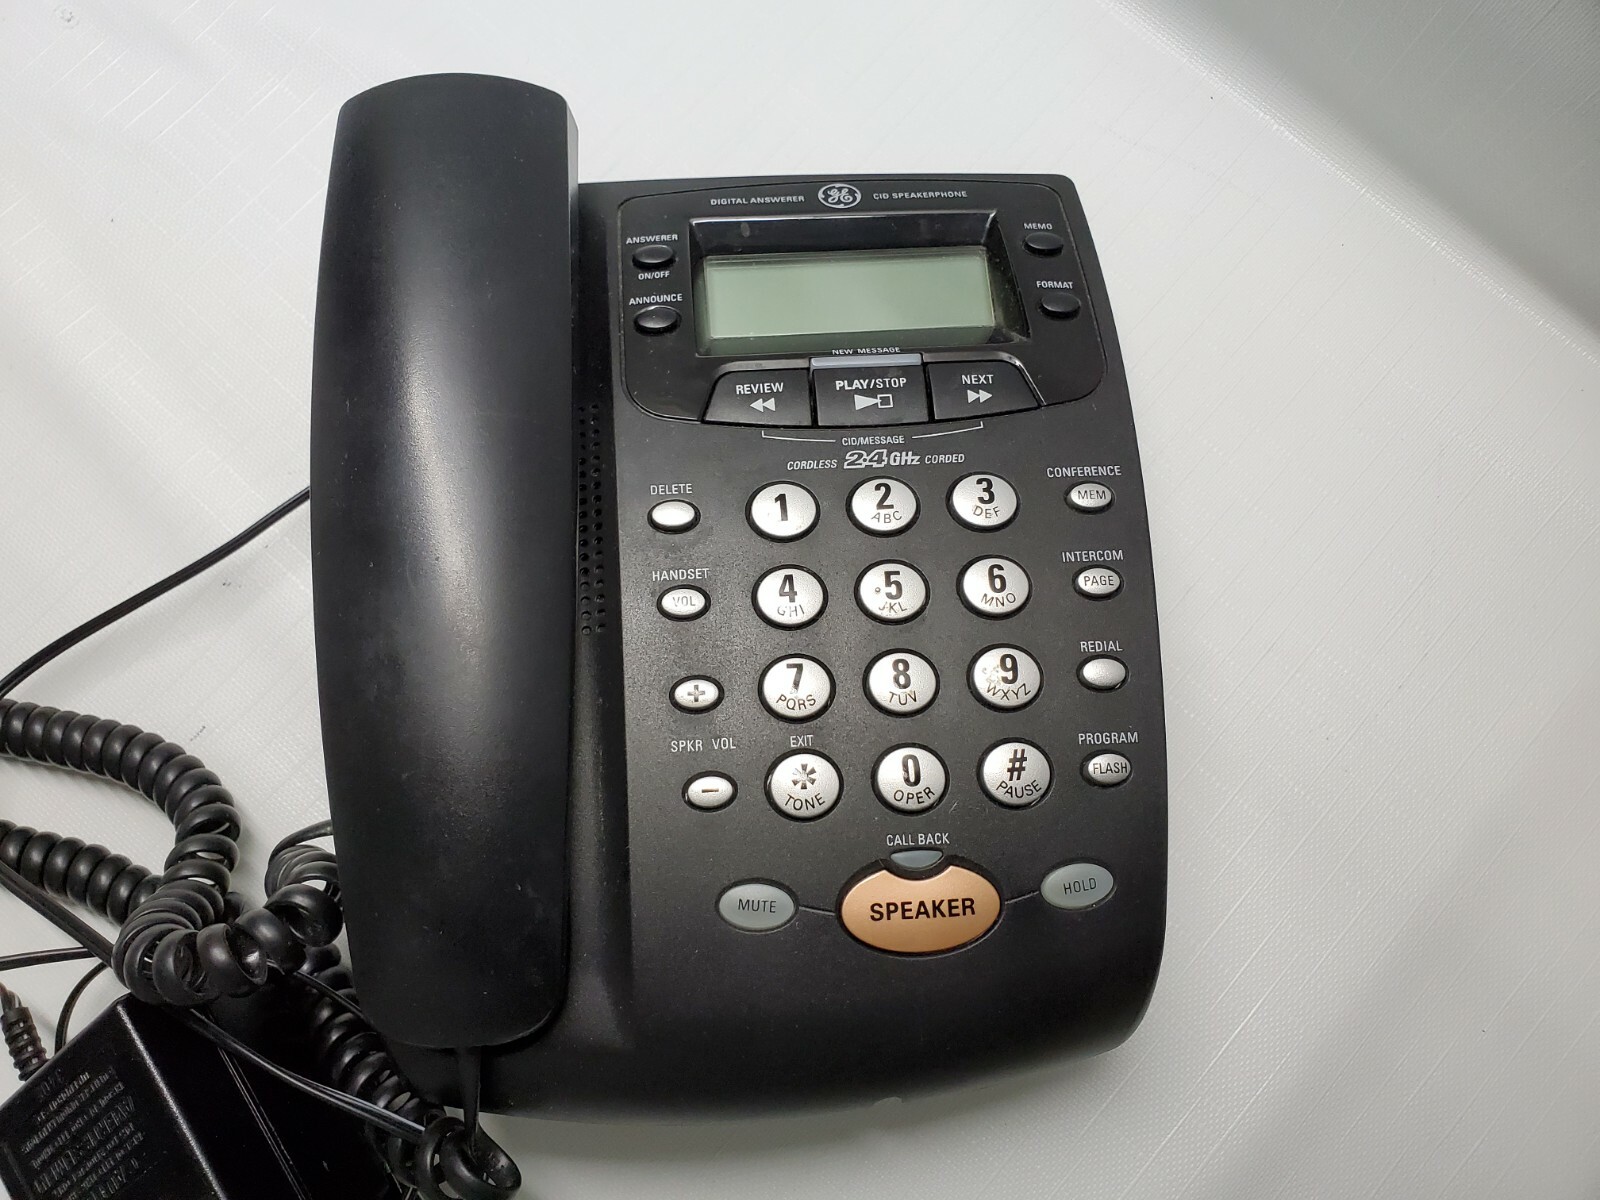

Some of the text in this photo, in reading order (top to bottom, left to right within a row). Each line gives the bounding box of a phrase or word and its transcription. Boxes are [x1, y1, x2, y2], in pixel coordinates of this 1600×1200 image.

[710, 195, 805, 206] DIGITAL ANSWERER
[892, 191, 967, 199] SPEAKERPHONE
[1024, 223, 1053, 231] MEMO
[626, 234, 678, 244] ANSWERER
[638, 271, 670, 280] ON/OFF
[1036, 281, 1074, 290] FORMAT
[629, 293, 683, 306] ANNOUNCE
[857, 346, 901, 354] MESSAGE
[835, 378, 907, 391] PLAY/STOP
[961, 374, 994, 385] NEXT
[735, 382, 784, 395] REVIEW
[842, 435, 905, 446] CID/MESSAGE
[787, 459, 838, 471] CORDLESS
[925, 454, 965, 465] CORDED
[1046, 465, 1122, 478] CONFERENCE
[650, 484, 693, 495] DELETE
[874, 483, 894, 510] 2
[975, 478, 995, 504] 3
[1077, 489, 1107, 500] MEM
[774, 493, 788, 521] 1
[972, 505, 1001, 519] DEF
[871, 510, 903, 524] ABC
[1061, 550, 1124, 562] INTERCOM
[652, 568, 710, 581] HANDSET
[987, 564, 1007, 593] 6
[1083, 575, 1115, 586] PAGE
[778, 574, 798, 603] 4
[884, 571, 903, 600] 5
[672, 596, 696, 607] VOL
[980, 592, 1017, 608] MNO
[776, 604, 805, 617] GHI
[878, 602, 908, 614] JKL
[1080, 640, 1124, 652] REDIAL
[892, 658, 912, 690] 8
[1000, 653, 1019, 685] 9
[786, 663, 804, 694] 7
[888, 691, 917, 706] TUV
[986, 683, 1032, 701] WXYZ
[775, 694, 817, 710] PQRS
[670, 737, 737, 753] SPKR VOL
[790, 735, 814, 748] EXIT
[1078, 731, 1139, 745] PROGRAM
[901, 754, 921, 788] 0
[1007, 748, 1028, 782] #
[1092, 762, 1129, 775] FLASH
[893, 786, 936, 805] OPER
[996, 779, 1042, 799] PAUSE
[784, 793, 826, 811] TONE
[886, 833, 950, 846] CALL BACK
[1063, 877, 1097, 895] HOLD
[737, 898, 777, 913] MUTE
[870, 897, 976, 922] SPEAKER
